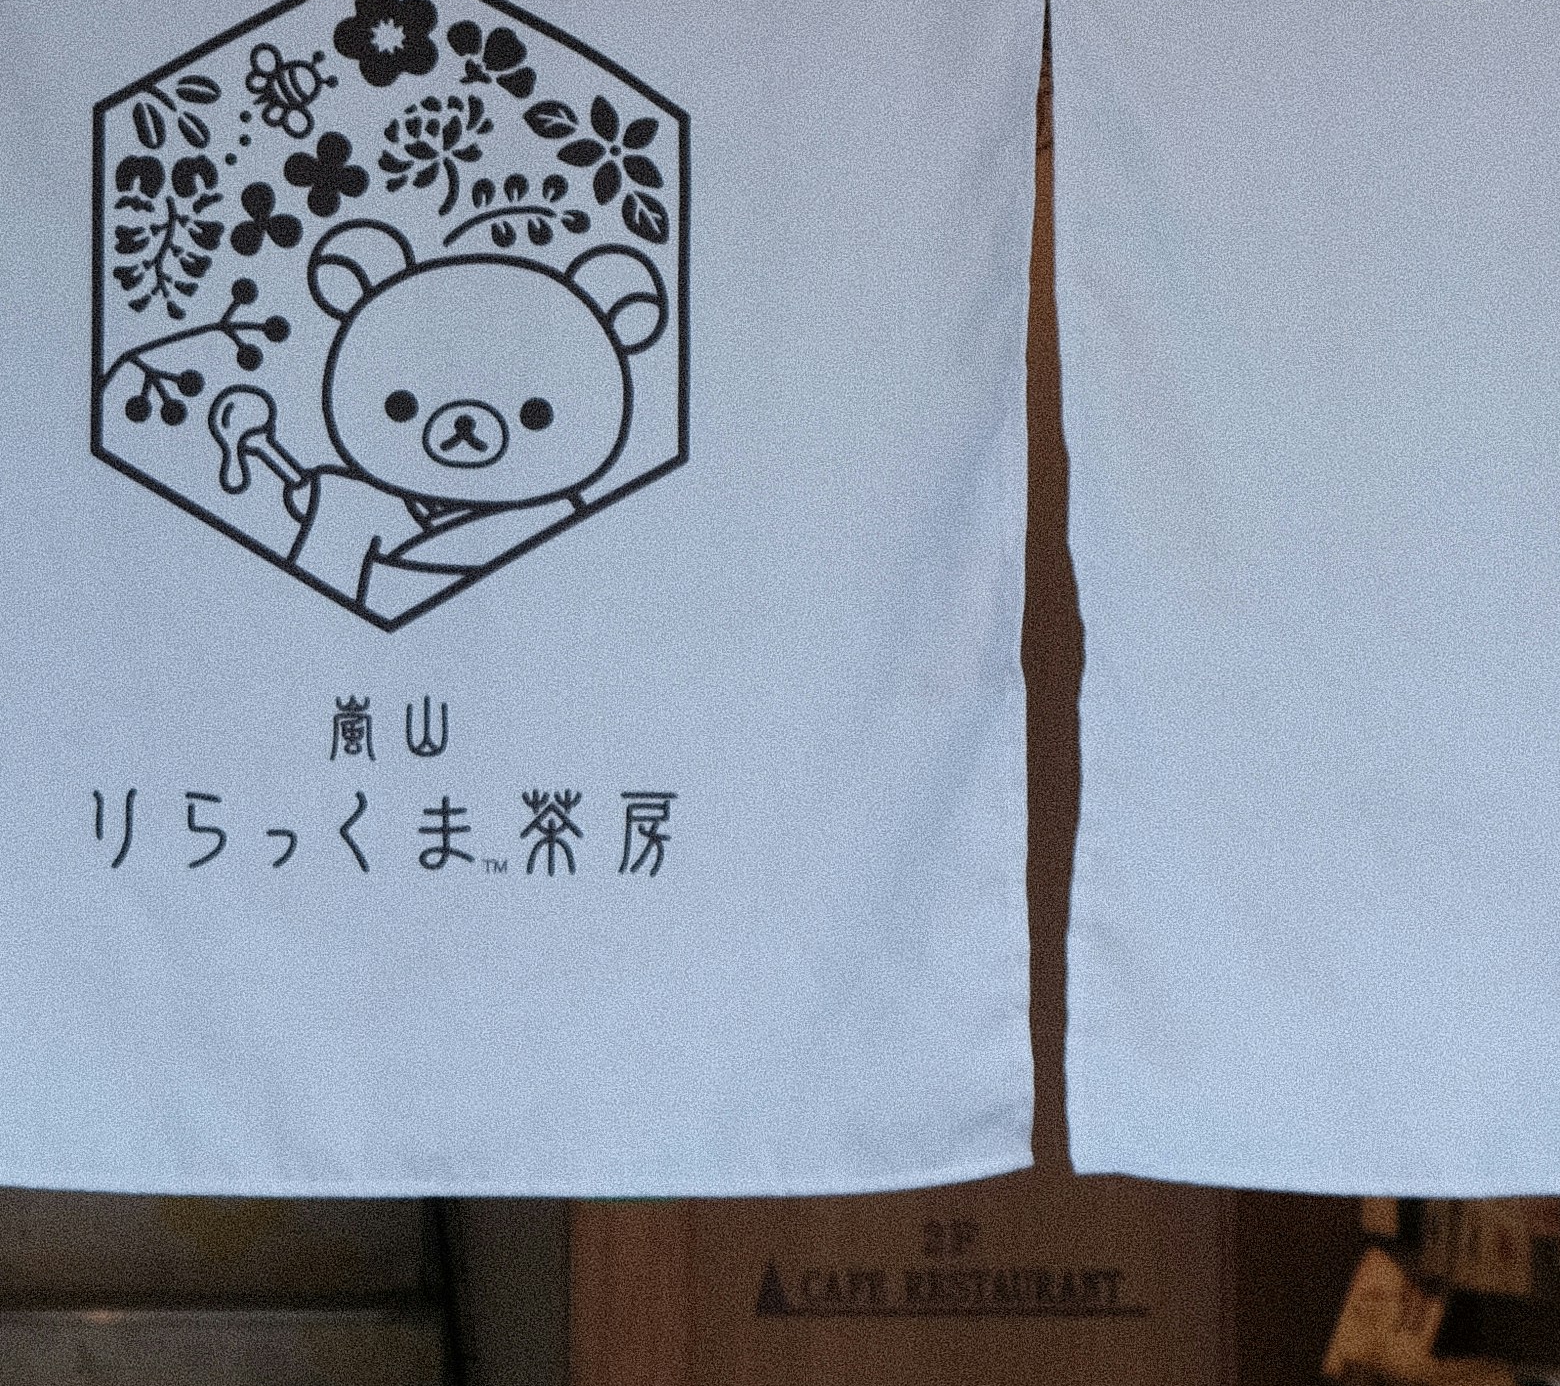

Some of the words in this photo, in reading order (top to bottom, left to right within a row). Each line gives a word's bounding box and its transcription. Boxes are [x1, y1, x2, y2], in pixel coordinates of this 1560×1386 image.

[330, 695, 448, 761] 嵐山
[801, 1269, 885, 1303] CAFE
[904, 1268, 1125, 1303] RESTAURANT
